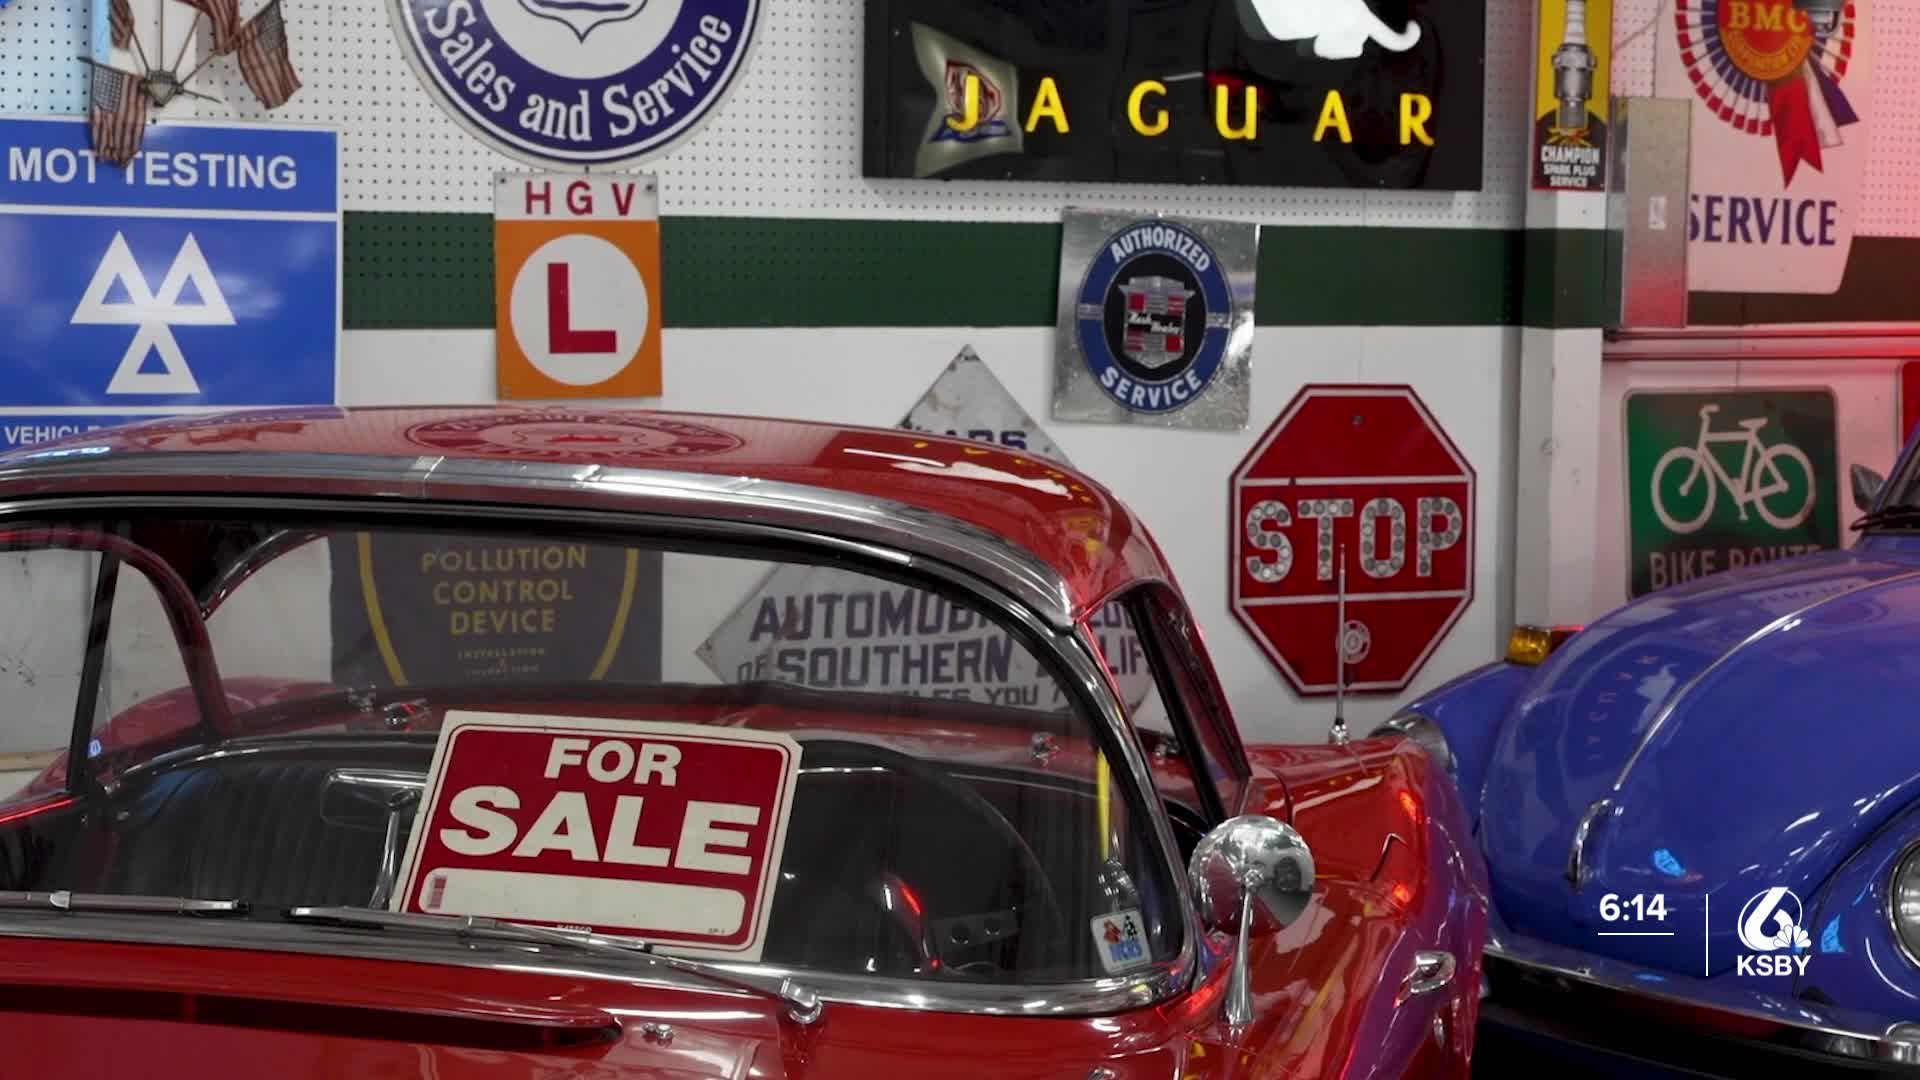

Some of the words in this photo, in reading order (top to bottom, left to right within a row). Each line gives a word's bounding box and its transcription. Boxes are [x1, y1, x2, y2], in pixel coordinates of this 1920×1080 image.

[1727, 1, 1809, 33] BMC
[424, 0, 516, 112] Sales
[519, 90, 592, 141] and
[602, 14, 732, 138] Service
[946, 75, 1434, 146] JAGUAR
[8, 147, 98, 184] MOT
[124, 151, 298, 190] TESTING
[1541, 145, 1600, 165] CHAMPION
[1573, 165, 1597, 177] PLUG
[1550, 175, 1588, 188] SERVICE
[1110, 226, 1211, 272] AUTHORIZED
[548, 263, 617, 354] L
[1100, 366, 1203, 409] SERVICE
[421, 545, 587, 573] POLLUTION
[1246, 497, 1463, 583] STOP
[433, 578, 576, 605] CONTROL
[451, 608, 557, 635] DEVICE
[776, 639, 1013, 687] SOUTHERN
[543, 737, 683, 787] FOR
[439, 785, 761, 876] SALE
